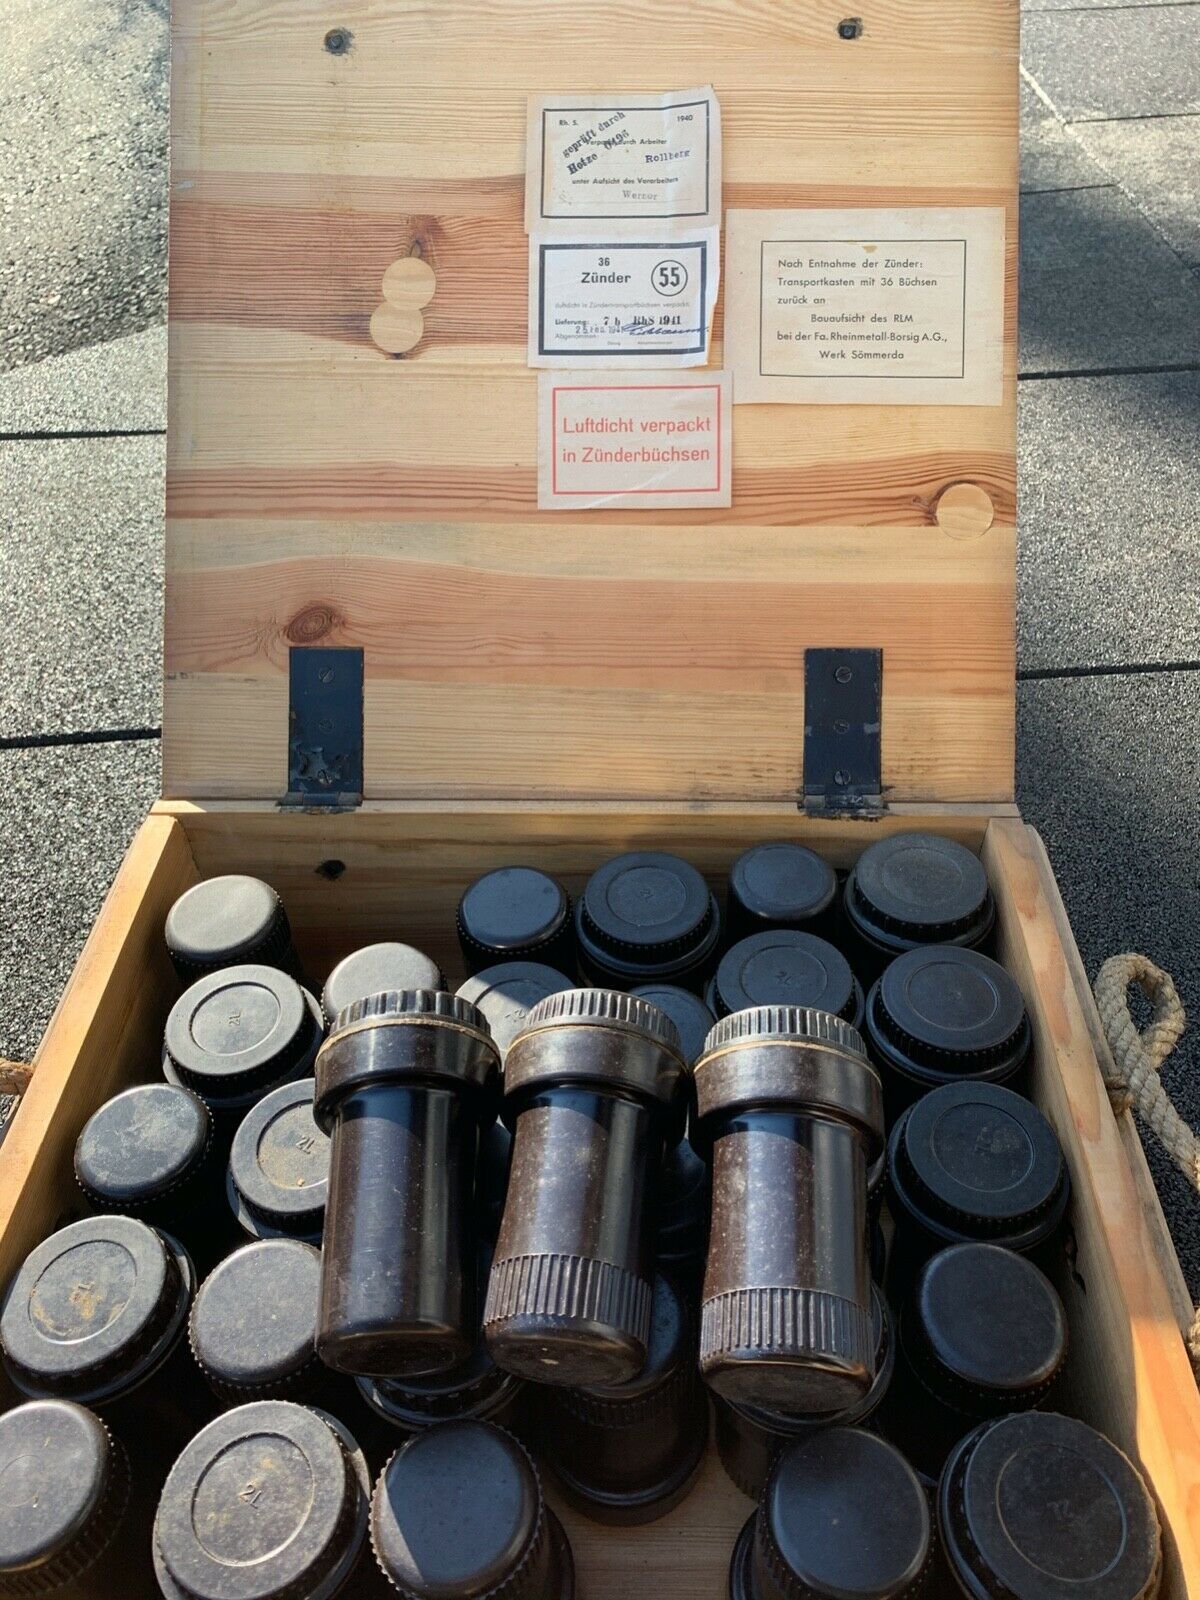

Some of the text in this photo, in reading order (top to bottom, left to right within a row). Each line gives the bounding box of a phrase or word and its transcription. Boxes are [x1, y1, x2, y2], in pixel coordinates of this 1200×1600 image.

[677, 114, 693, 123] 1940
[645, 149, 690, 163] Rollberg
[592, 177, 620, 185] Aufsicht
[598, 257, 610, 267] 36
[778, 259, 923, 269] Nach Entnahme der Zünder:
[581, 272, 632, 284] Zünder
[658, 266, 681, 288] 55
[777, 277, 938, 288] Transportkasten mit 36 Büchsen
[777, 294, 826, 305] zurück an
[659, 315, 681, 325] 1941
[810, 313, 914, 323] Bauaufsicht des RLM
[777, 331, 792, 341] bei
[795, 331, 811, 341] der
[819, 350, 905, 360] Werk Sömmerda
[563, 416, 711, 436] Luftdicht verpackt
[563, 446, 710, 463] in Zünderbüchsen
